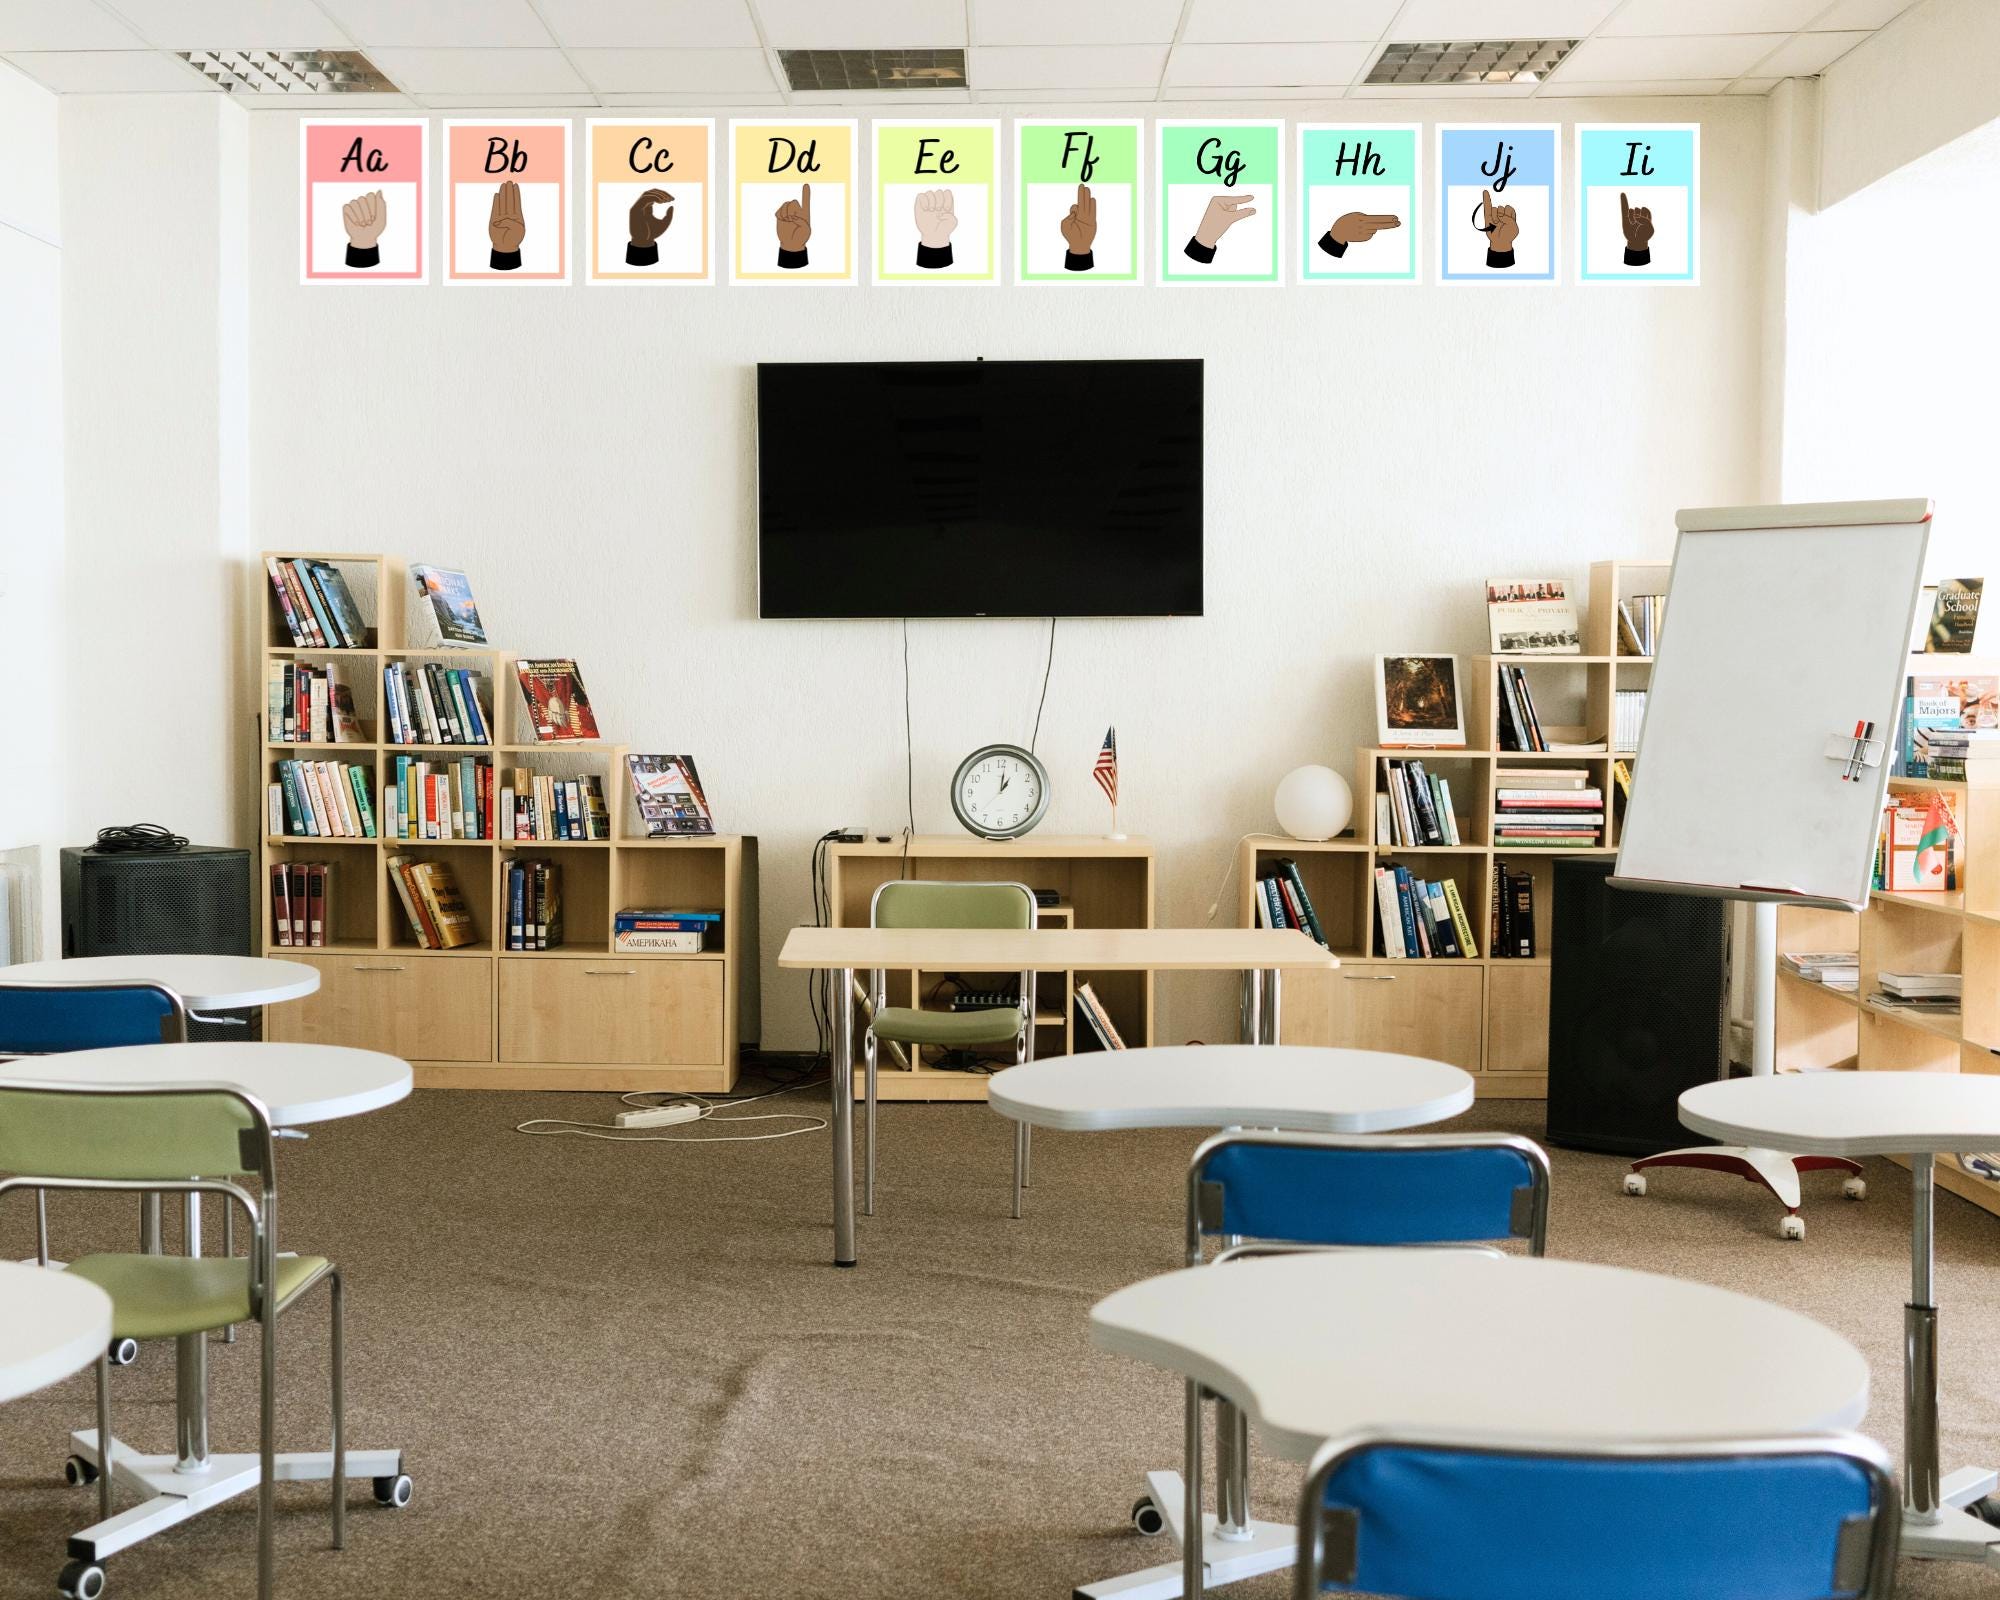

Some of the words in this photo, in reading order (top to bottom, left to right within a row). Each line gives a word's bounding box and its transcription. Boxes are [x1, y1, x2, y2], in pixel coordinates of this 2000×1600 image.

[340, 137, 389, 172] Aa
[484, 136, 528, 174] Bb
[629, 136, 674, 174] Cc
[768, 137, 821, 174] Dd
[914, 138, 960, 175] Ee
[1061, 131, 1100, 183] Ff
[1335, 141, 1386, 177] Hh
[1620, 142, 1655, 176] Ii
[1196, 137, 1247, 188] Gg
[1480, 141, 1517, 193] Jj
[1938, 588, 1980, 600] Graduate
[1944, 600, 1979, 612] School
[1919, 706, 1956, 716] Majors
[982, 763, 991, 772] 11
[997, 759, 1006, 769] 12
[970, 774, 980, 783] 10
[1024, 773, 1030, 783] 2
[287, 779, 296, 808] Congress
[967, 788, 973, 797] 9
[1028, 788, 1034, 797] 3
[971, 803, 977, 812] 8
[1024, 803, 1029, 812] 4
[983, 814, 988, 823] 7
[997, 817, 1003, 826] 6
[1012, 813, 1018, 823] 5
[1269, 880, 1283, 914] CULTURAL
[1449, 889, 1461, 911] AMERICAN
[1402, 895, 1411, 925] AMERICAN
[626, 939, 677, 947] АМЕРИКАНА
